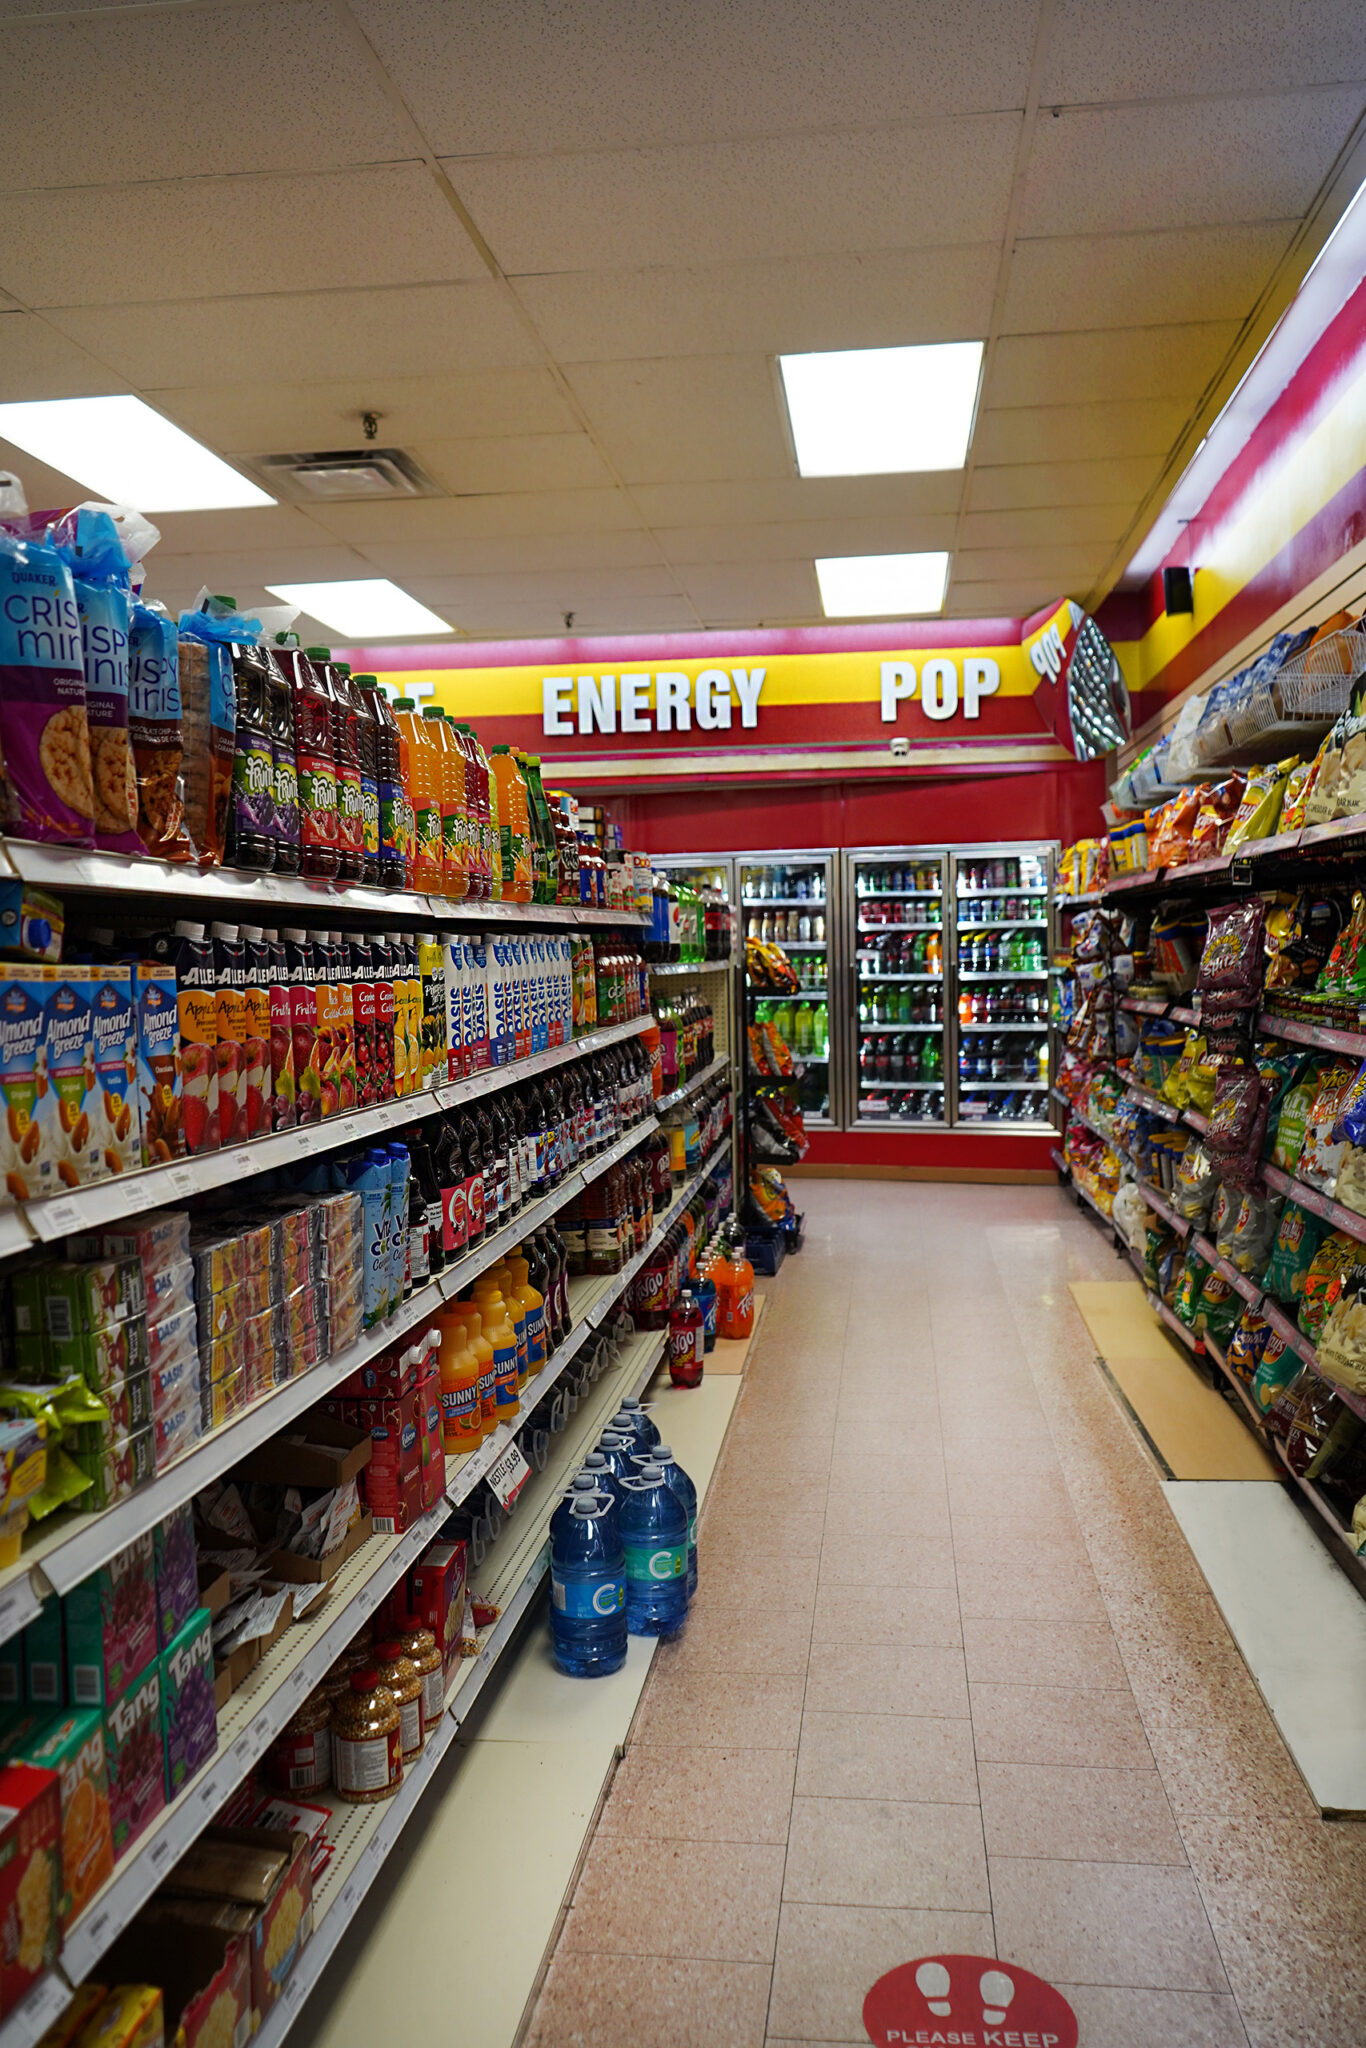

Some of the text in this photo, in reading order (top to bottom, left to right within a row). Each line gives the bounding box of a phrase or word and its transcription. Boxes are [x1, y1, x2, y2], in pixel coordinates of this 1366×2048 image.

[12, 571, 56, 587] QUAKER
[543, 668, 767, 736] ENERGY
[880, 657, 1000, 723] POP
[93, 1007, 131, 1038] Almond
[143, 1005, 177, 1036] Almond
[450, 987, 462, 1050] OASIS
[475, 984, 486, 1042] OASIS
[493, 982, 506, 1039] OASIS
[47, 1010, 91, 1045] Almond
[99, 1030, 125, 1054] Breeze
[149, 1026, 173, 1049] Breeze
[3, 1038, 36, 1064] Breeze
[54, 1034, 84, 1060] Breeze
[160, 1363, 184, 1388] OASIS
[442, 1387, 478, 1408] SUNNY
[163, 1410, 186, 1437] OASIS
[489, 1449, 521, 1489] NESTLE $3.99
[168, 1626, 212, 1689] Tang
[108, 1673, 161, 1744] Tang
[887, 2029, 1059, 2048] PLEASE KEEP
